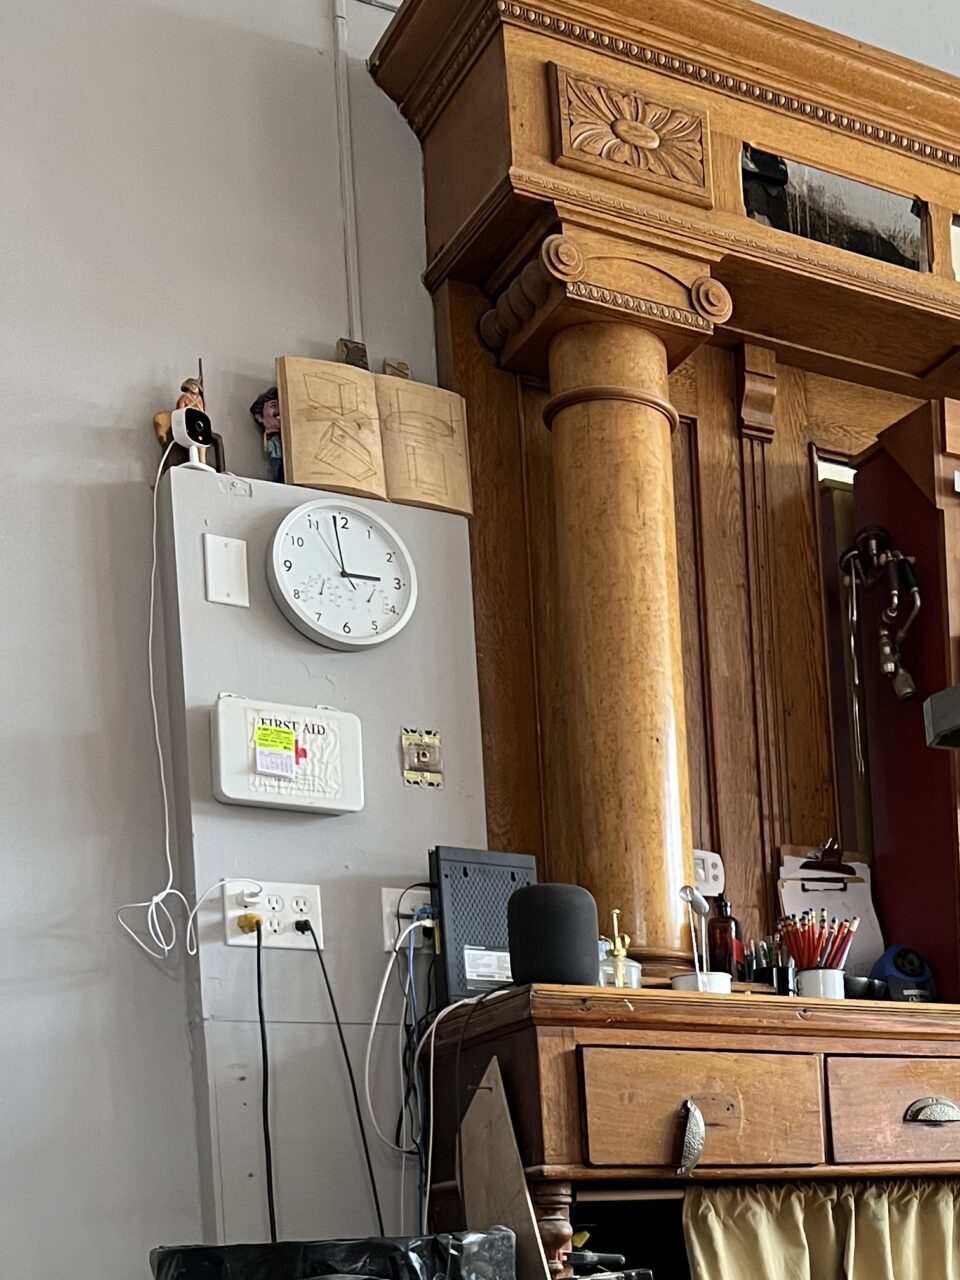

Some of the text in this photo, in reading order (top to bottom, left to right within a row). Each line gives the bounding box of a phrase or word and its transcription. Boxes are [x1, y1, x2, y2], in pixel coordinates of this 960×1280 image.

[291, 535, 304, 547] 10
[386, 553, 393, 563] 2
[283, 560, 293, 572] 9
[393, 577, 401, 590] 3
[293, 589, 300, 600] 8
[389, 605, 396, 615] 4
[315, 612, 322, 622] 7
[343, 622, 351, 634] 6
[371, 621, 378, 631] 5
[303, 723, 326, 736] AID
